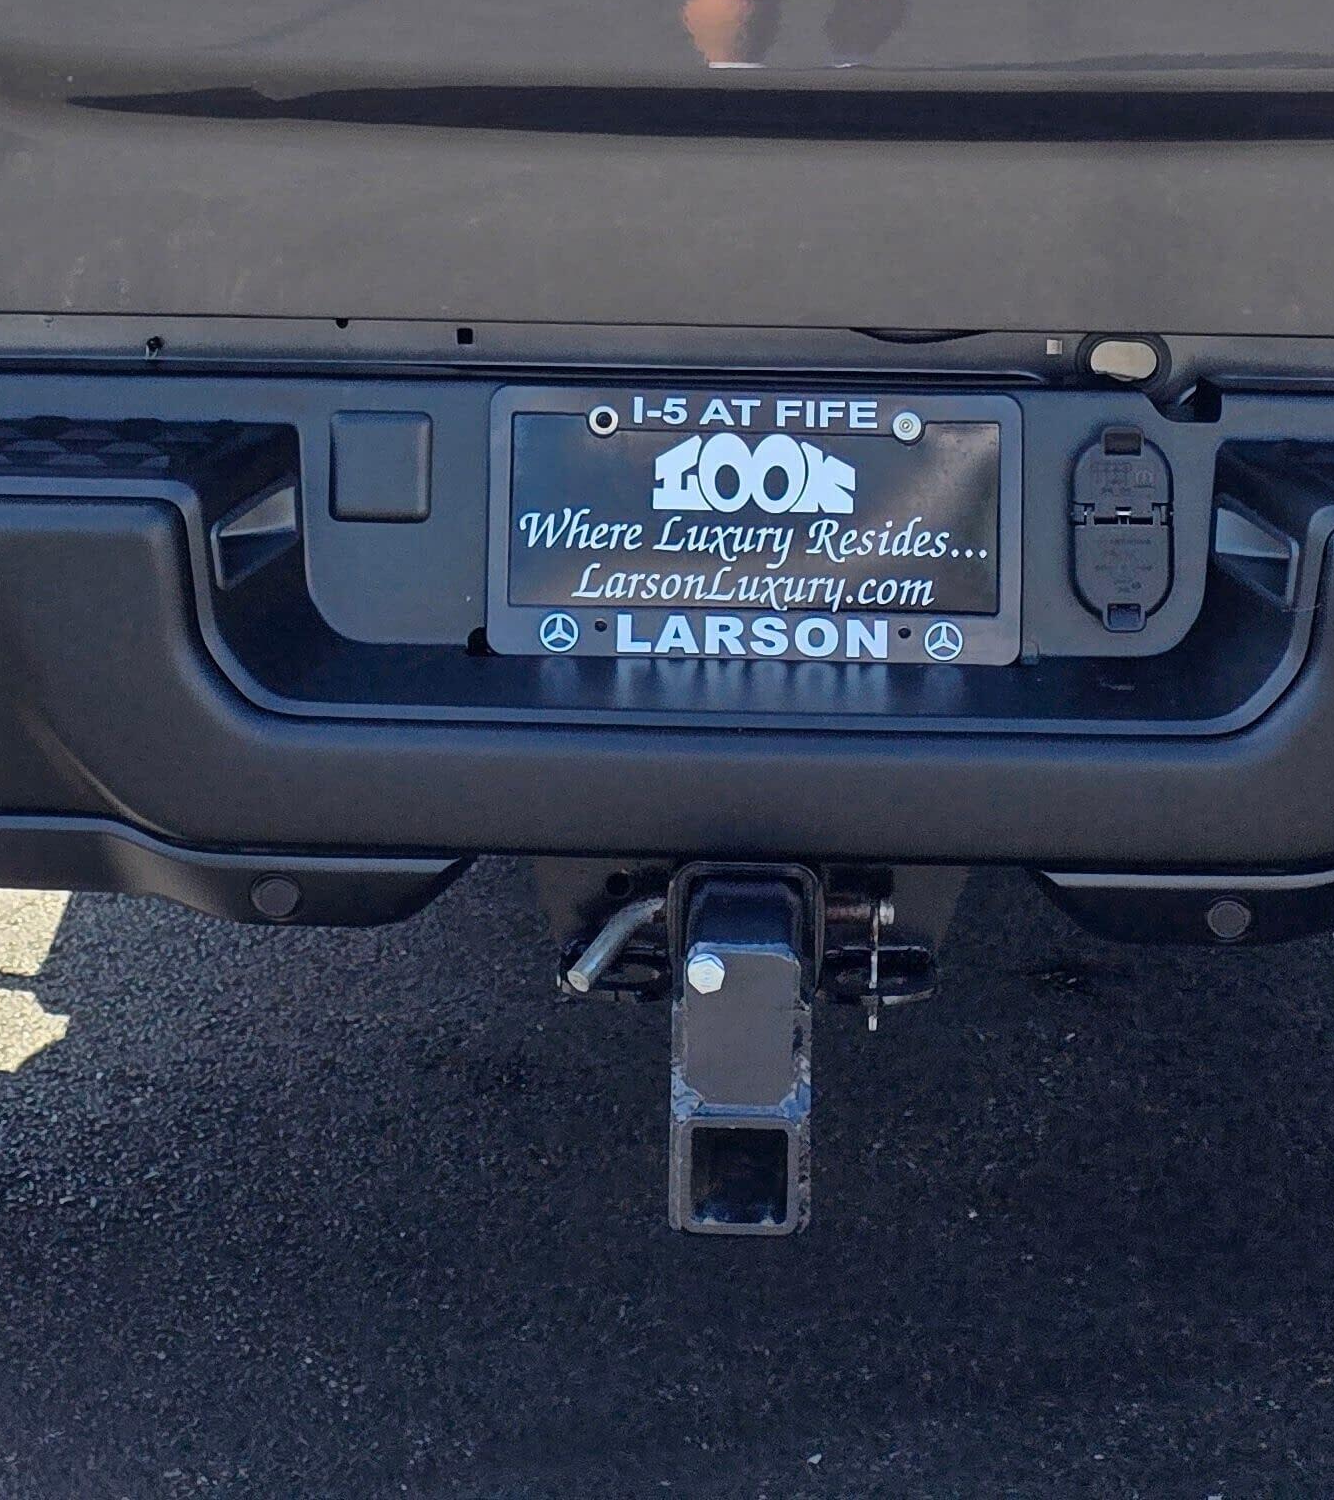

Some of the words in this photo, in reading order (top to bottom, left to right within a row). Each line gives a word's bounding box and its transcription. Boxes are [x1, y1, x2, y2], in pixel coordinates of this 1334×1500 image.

[633, 397, 687, 426] I-5
[699, 399, 760, 426] AT
[775, 400, 878, 429] FIFE
[519, 508, 642, 550] Where
[654, 517, 796, 568] Luxury
[808, 517, 987, 563] Resides...
[571, 563, 934, 613] LarsonLuxury.com
[616, 615, 889, 659] LARSON
